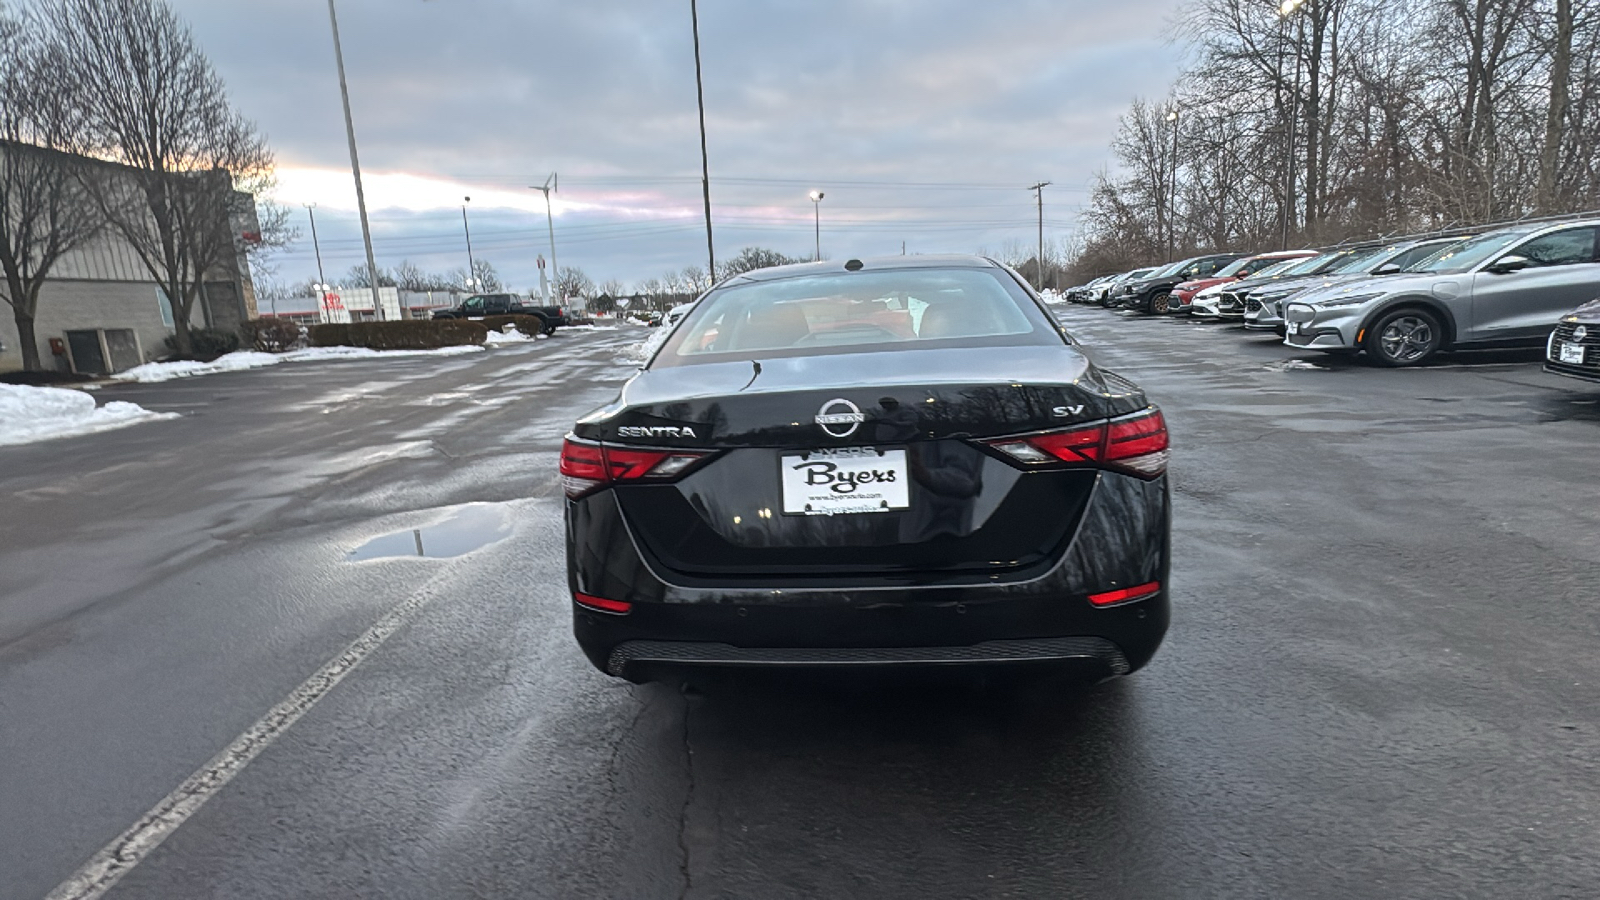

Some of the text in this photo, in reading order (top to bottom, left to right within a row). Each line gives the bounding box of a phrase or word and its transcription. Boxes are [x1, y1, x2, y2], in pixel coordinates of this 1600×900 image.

[1052, 404, 1085, 417] SV
[815, 413, 865, 424] NISSAN
[618, 426, 697, 438] SENTRA
[792, 461, 896, 493] Byers
